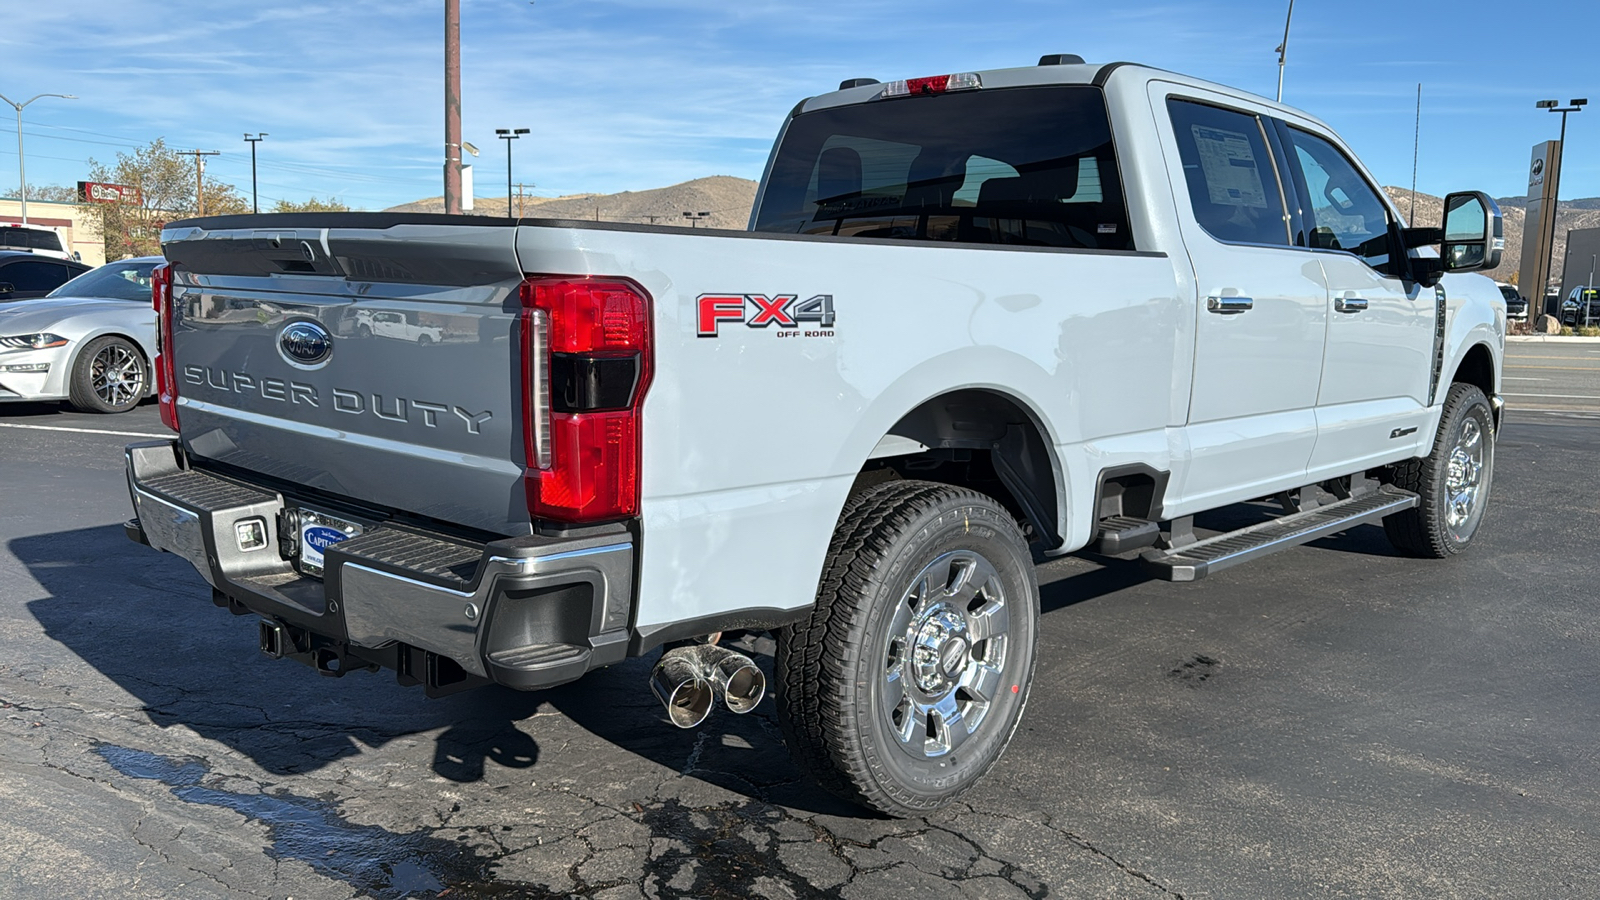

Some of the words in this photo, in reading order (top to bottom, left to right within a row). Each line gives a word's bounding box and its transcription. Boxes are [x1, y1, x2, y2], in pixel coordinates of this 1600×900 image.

[696, 293, 836, 338] FX4
[805, 330, 835, 338] ROAD
[184, 363, 320, 408] SUPER
[332, 387, 494, 435] DUTY
